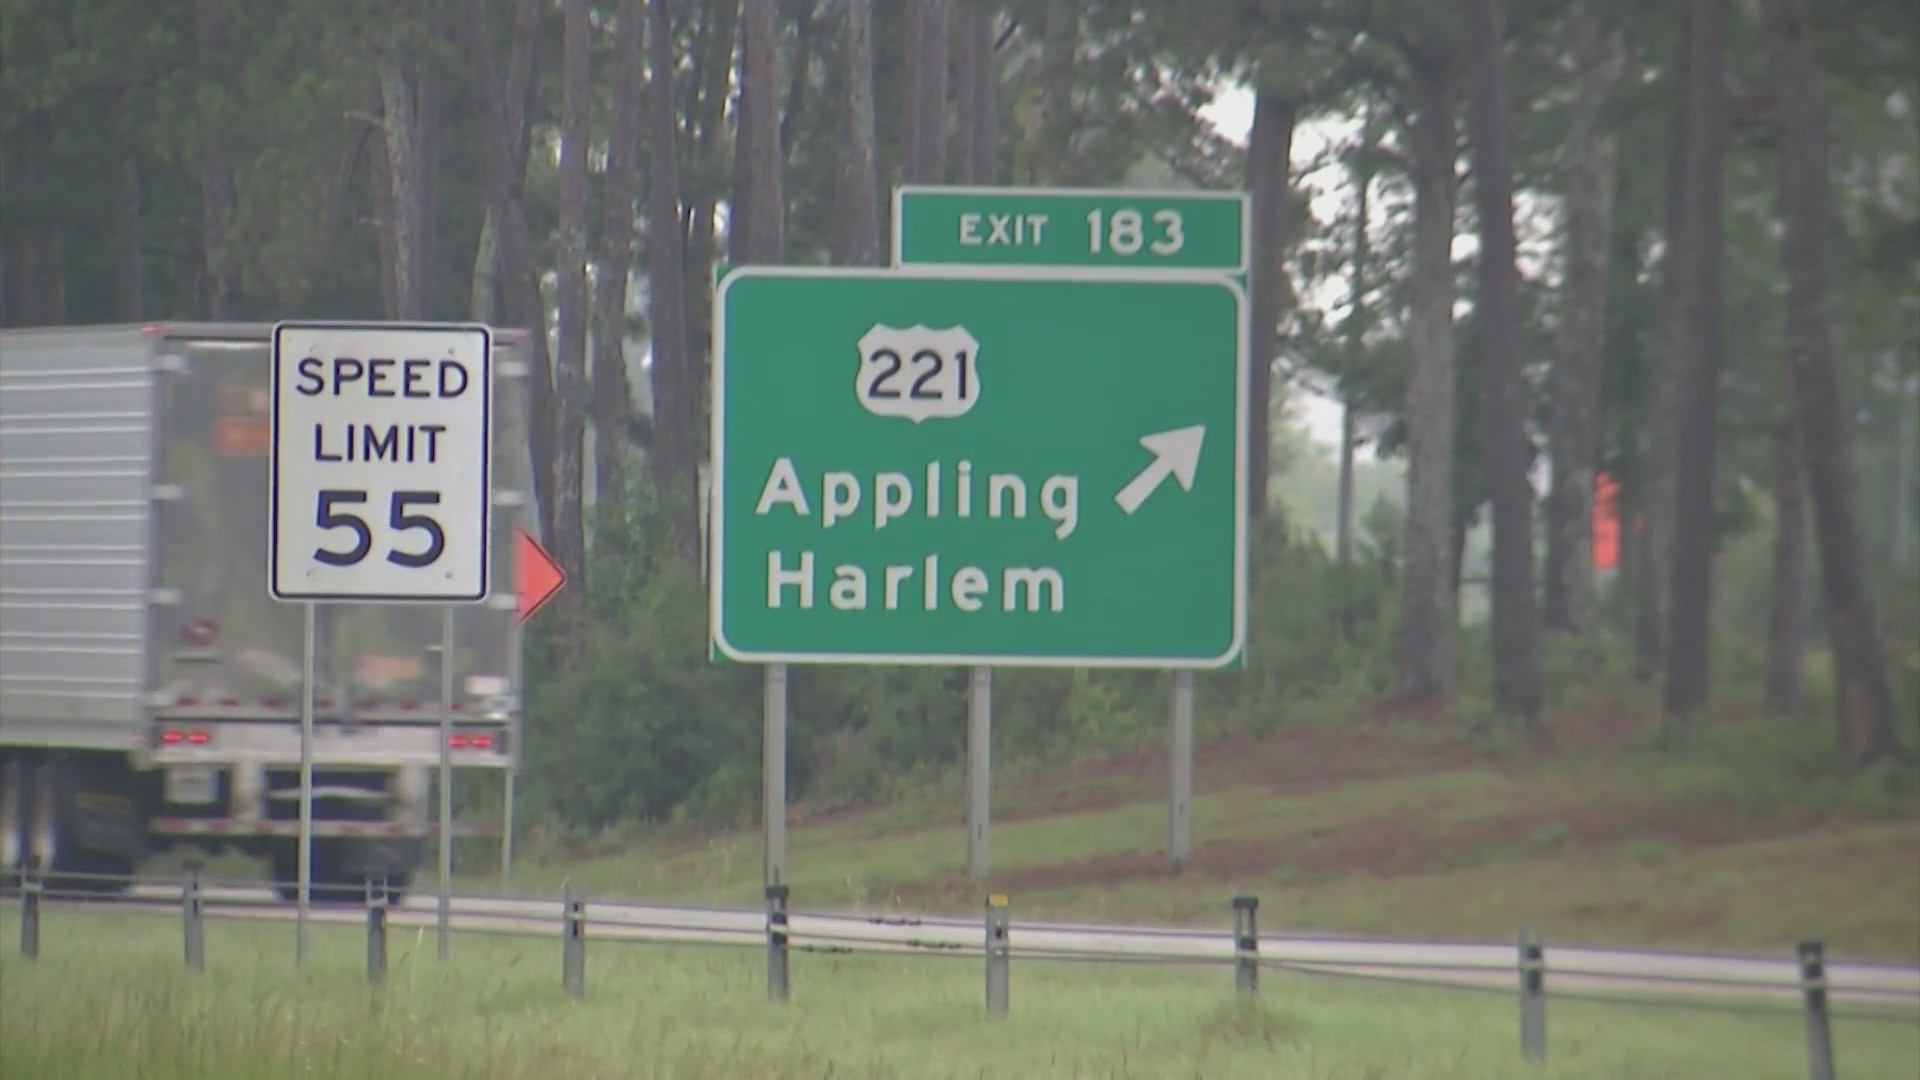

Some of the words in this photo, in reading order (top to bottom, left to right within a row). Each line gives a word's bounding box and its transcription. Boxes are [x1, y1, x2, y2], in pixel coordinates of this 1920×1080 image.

[959, 213, 1048, 246] EXIT
[1087, 209, 1185, 255] 183
[295, 355, 470, 400] SPEED
[867, 347, 968, 401] 221
[313, 422, 448, 465] LIMIT
[756, 457, 1079, 540] Appling
[312, 488, 447, 570] 55
[767, 550, 1065, 613] Harlem
